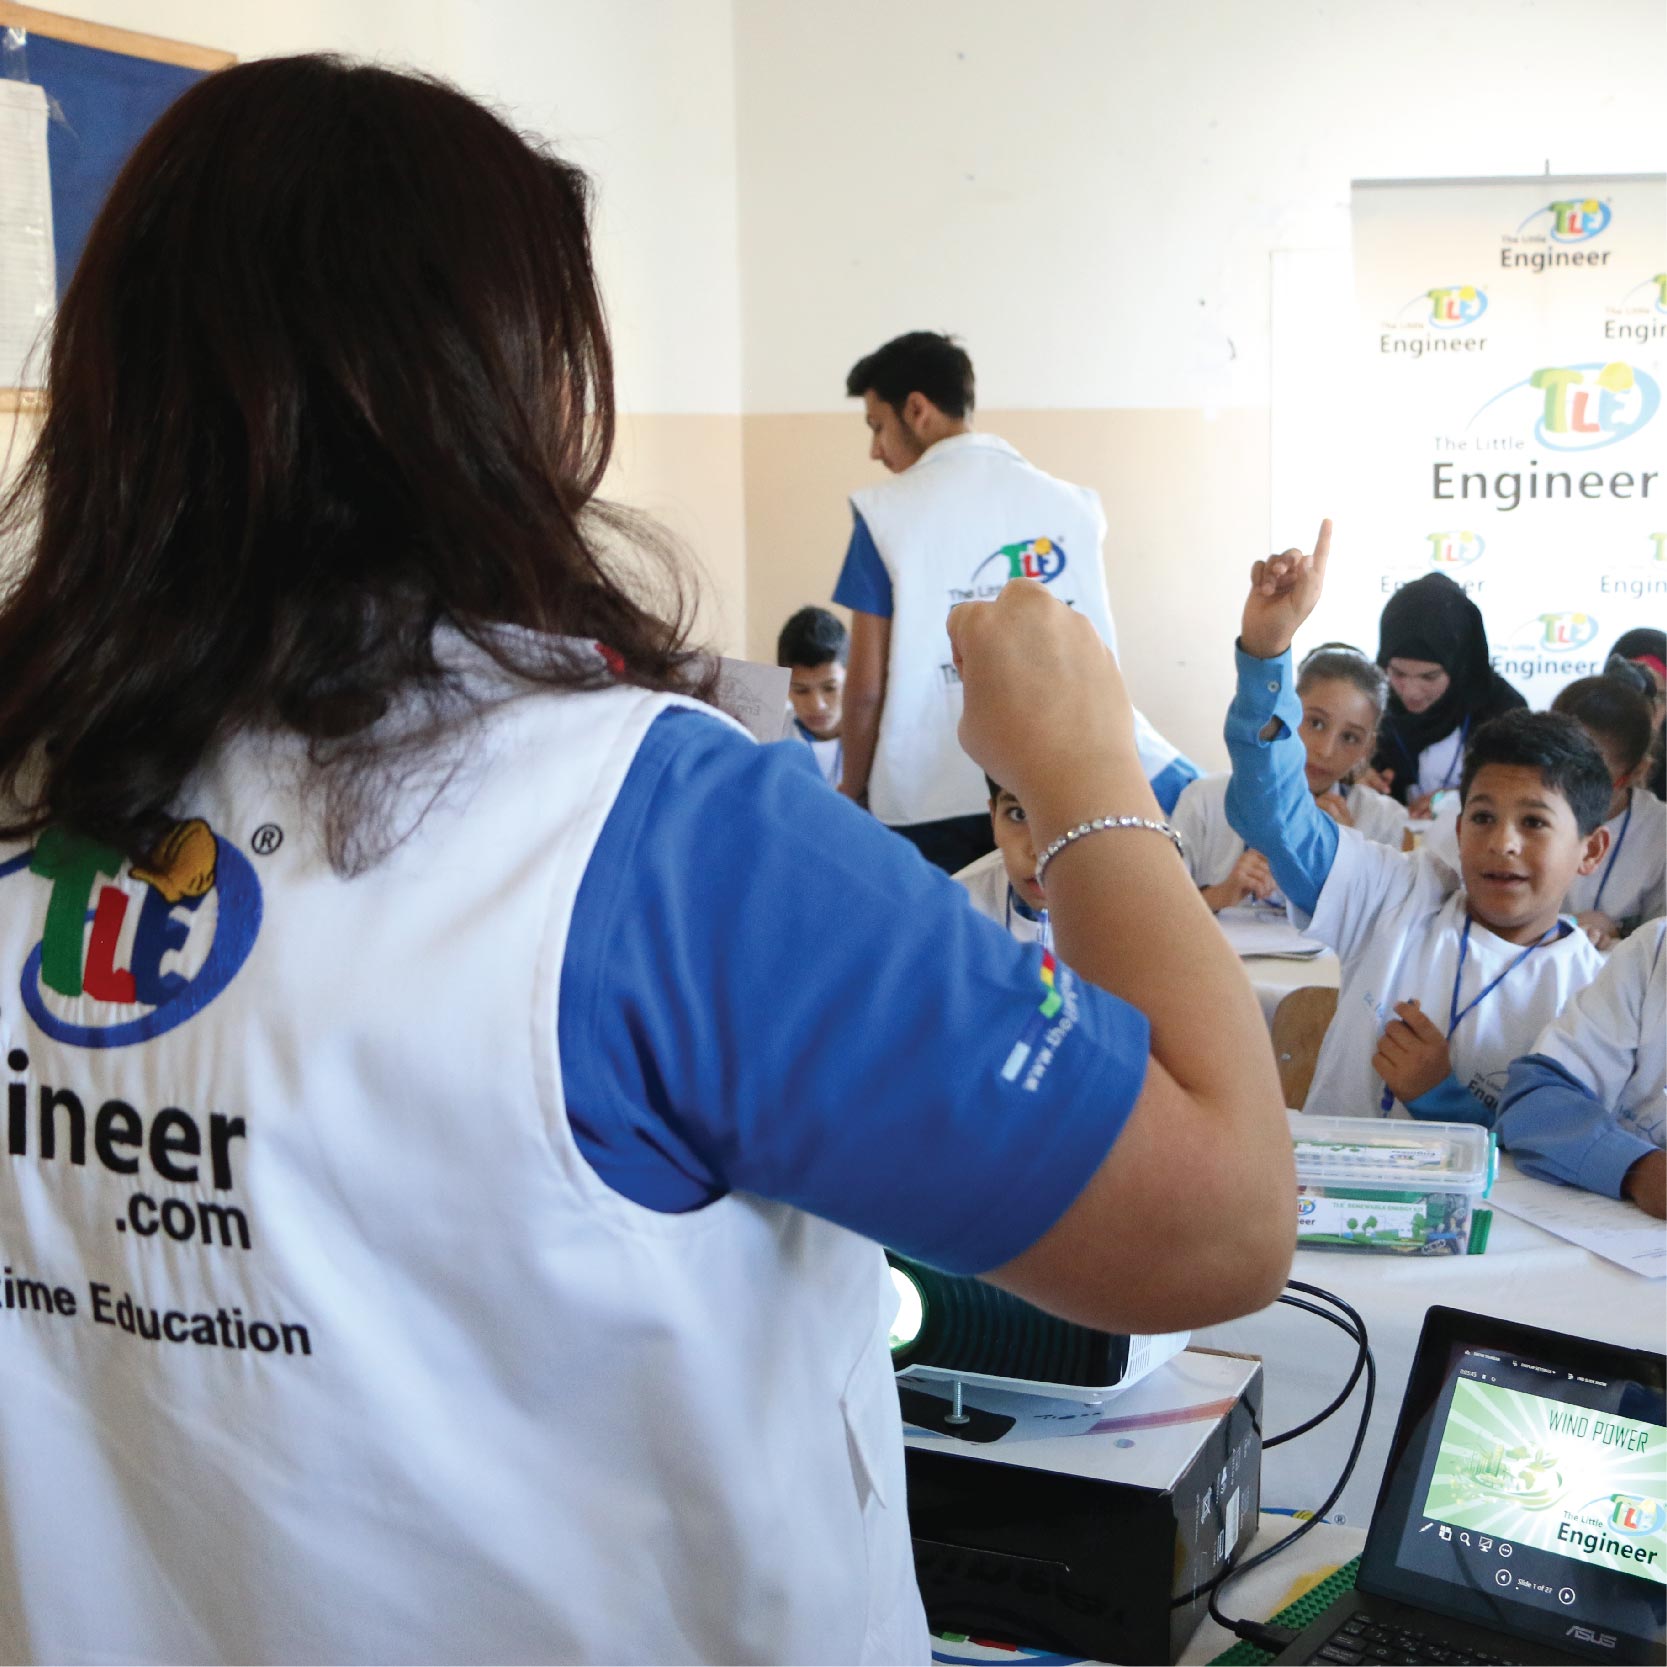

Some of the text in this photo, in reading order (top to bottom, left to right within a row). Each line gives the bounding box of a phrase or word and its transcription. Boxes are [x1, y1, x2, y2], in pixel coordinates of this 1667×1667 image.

[1500, 247, 1612, 273] Engineer
[1379, 332, 1488, 359] Engineer
[1434, 436, 1525, 451] The Little
[1432, 459, 1659, 512] Engineer
[1491, 654, 1599, 682] Engineer
[115, 1191, 252, 1251] .com
[0, 1266, 313, 1357] ime Education
[1549, 1409, 1649, 1454] WIND POWER
[1563, 1510, 1604, 1528] The Little
[1557, 1521, 1658, 1565] Engineer
[1517, 1578, 1533, 1589] Slide
[1565, 1625, 1618, 1649] ASUS
